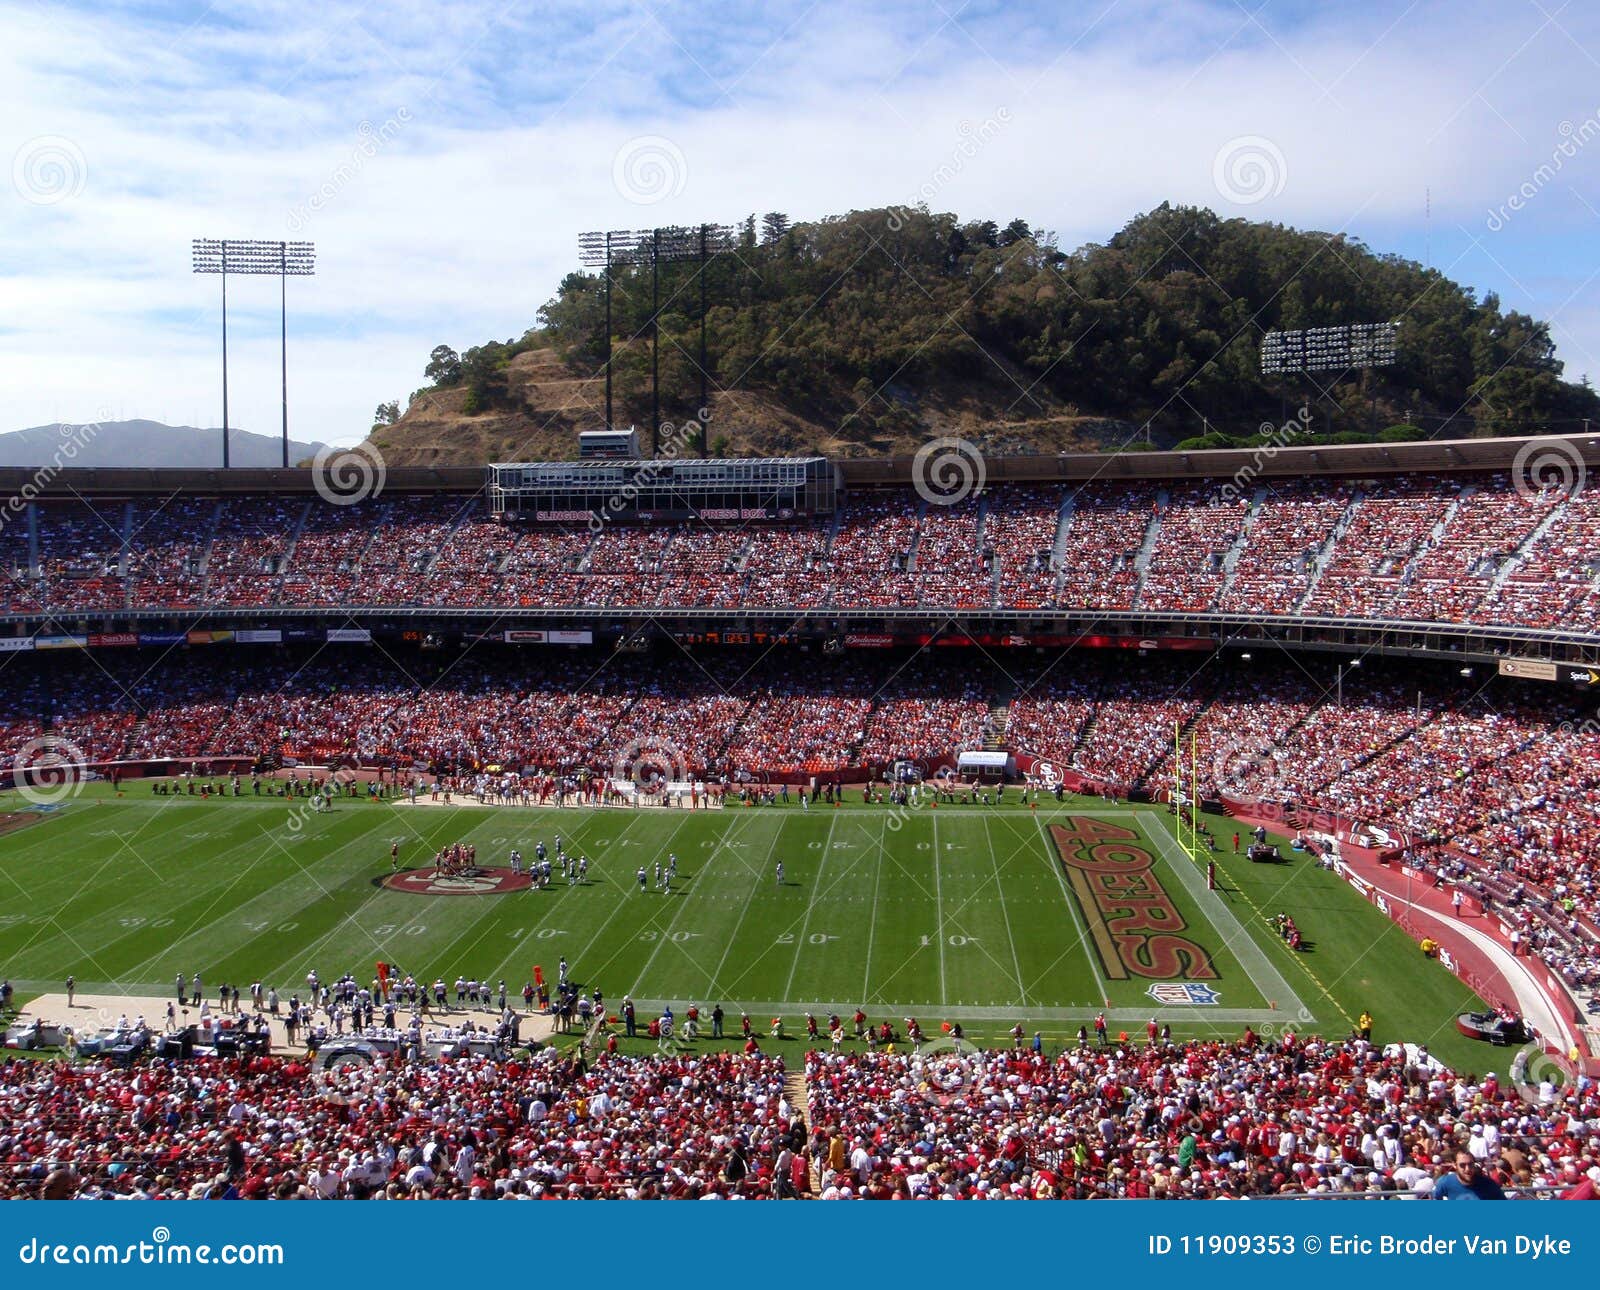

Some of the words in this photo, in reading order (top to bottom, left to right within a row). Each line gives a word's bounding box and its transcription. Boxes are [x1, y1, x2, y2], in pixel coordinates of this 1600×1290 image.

[536, 510, 593, 521] SLINGBOX
[700, 509, 739, 520] PRESS
[741, 508, 767, 520] BOX
[1569, 671, 1591, 682] Sprint
[1048, 815, 1222, 980] 49ERS
[1344, 1134, 1357, 1147] 21
